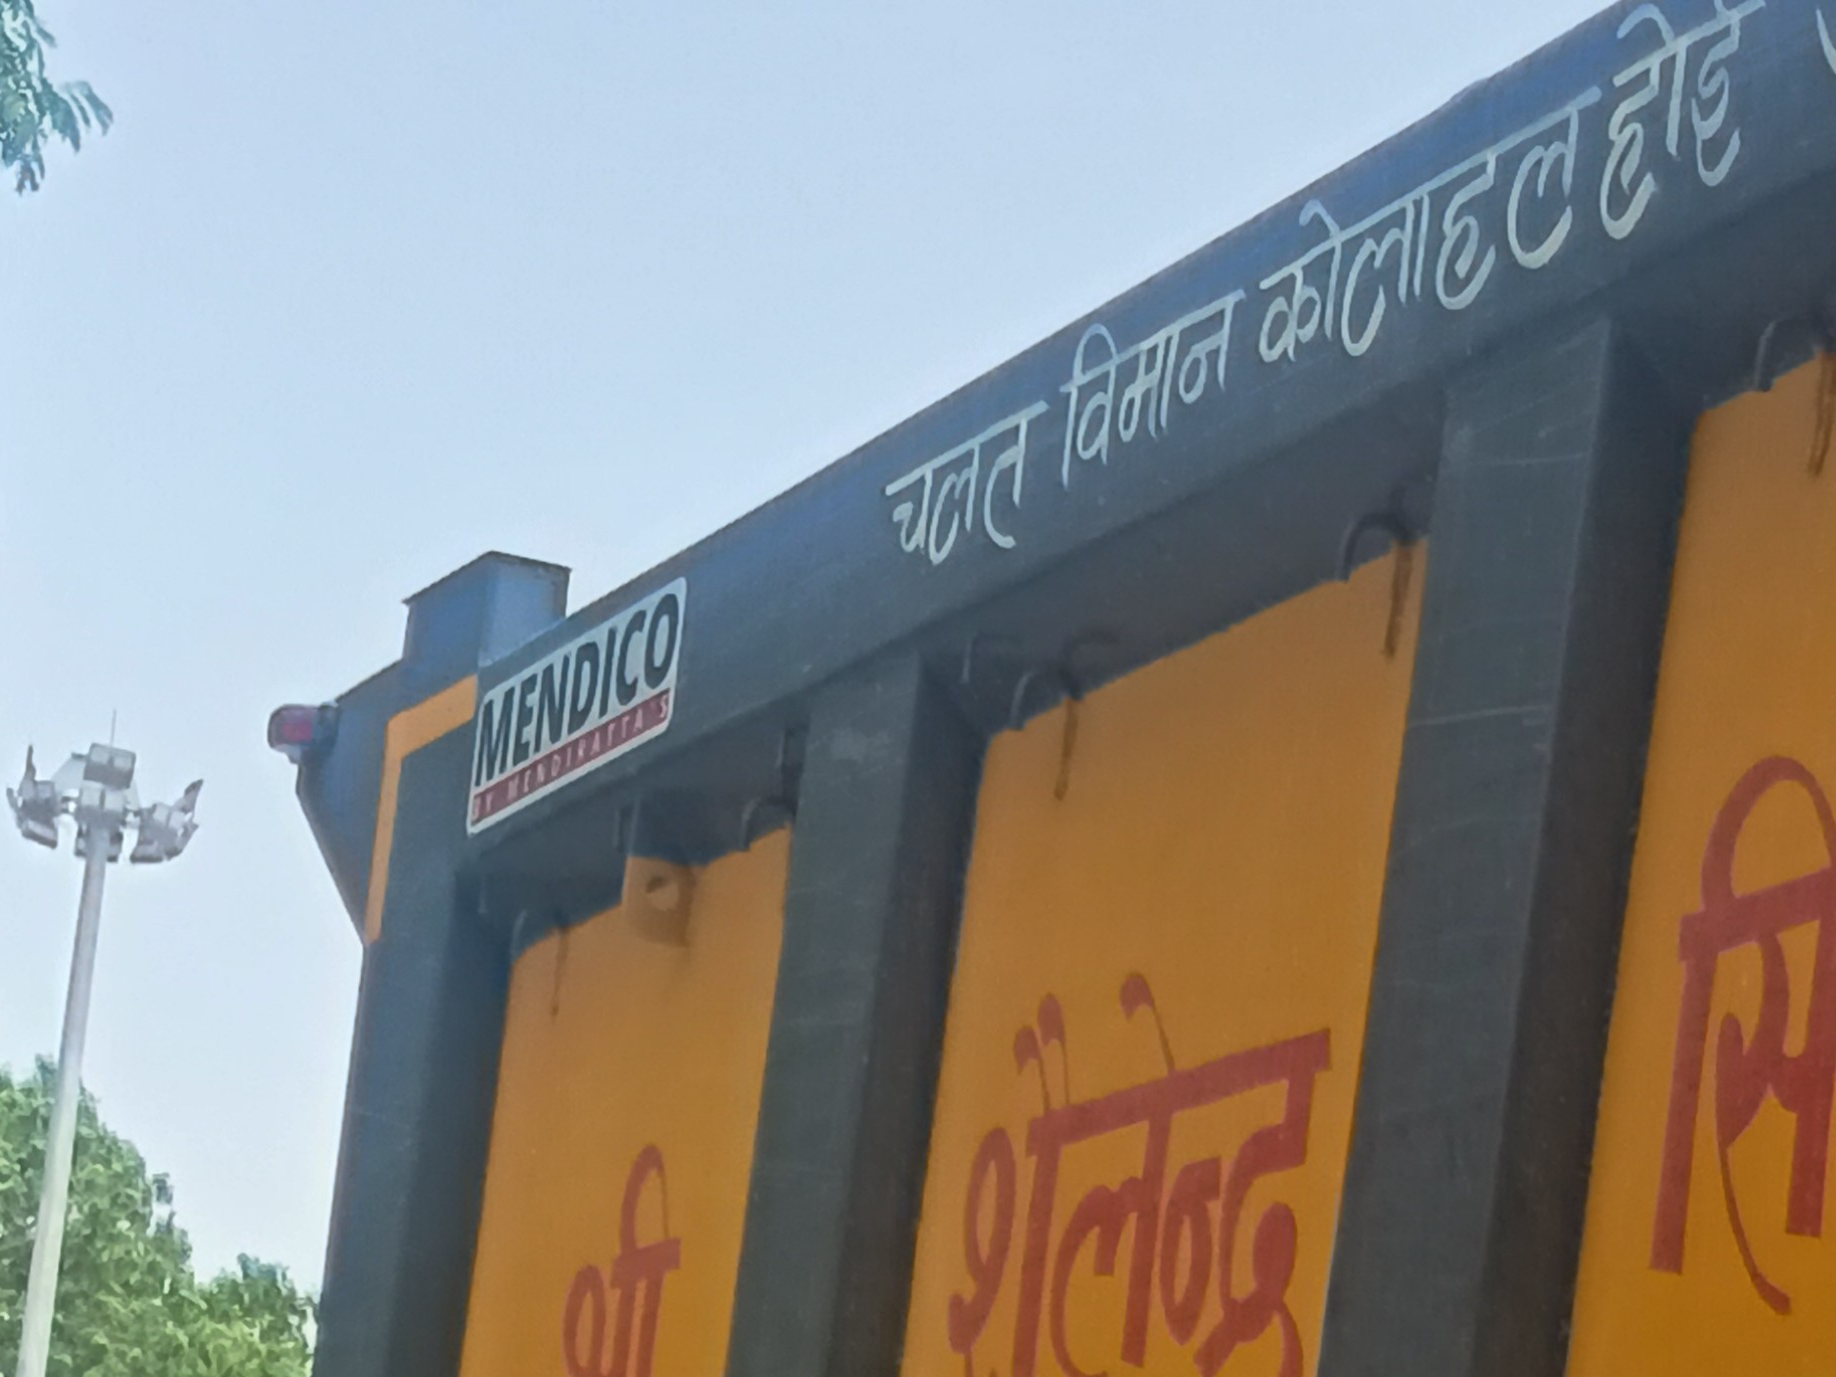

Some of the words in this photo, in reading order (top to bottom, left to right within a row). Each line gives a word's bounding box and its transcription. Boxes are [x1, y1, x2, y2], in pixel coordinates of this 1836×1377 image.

[886, 402, 1048, 565] चलत
[1059, 323, 1245, 489] विमान
[1258, 88, 1601, 364] कोलाहल
[474, 593, 680, 787] MENDICO
